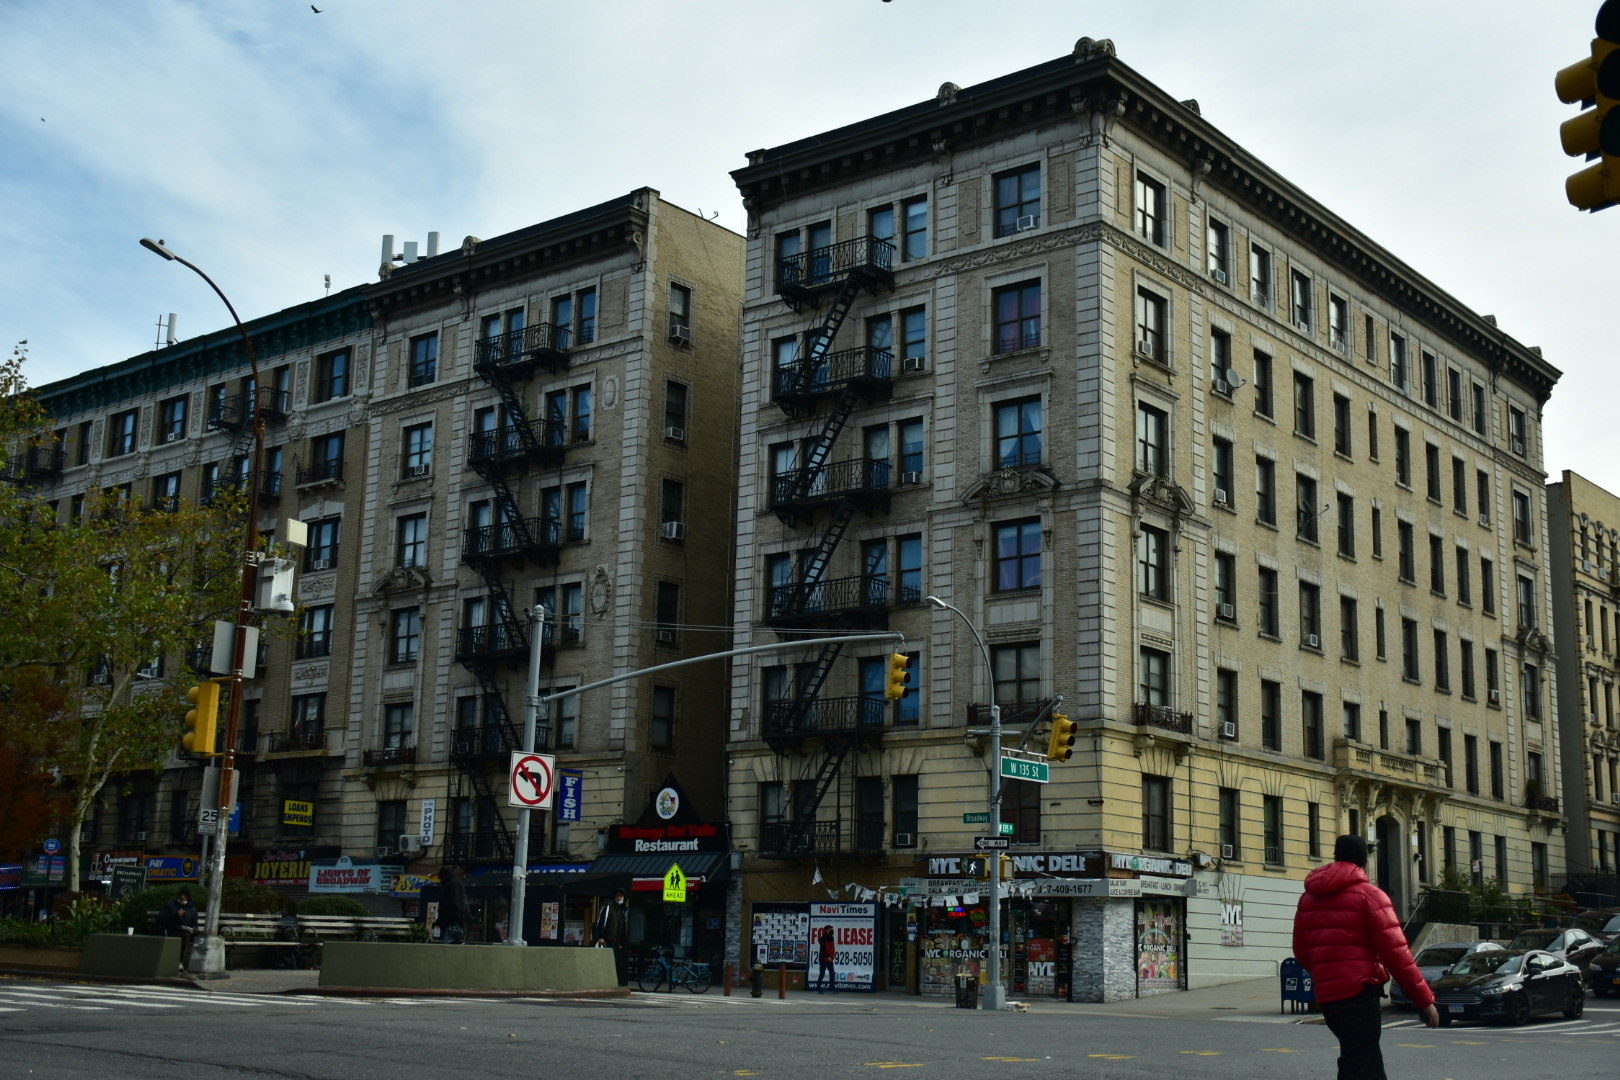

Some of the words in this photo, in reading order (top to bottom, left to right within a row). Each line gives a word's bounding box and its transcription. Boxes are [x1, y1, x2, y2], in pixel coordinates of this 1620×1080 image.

[1011, 762, 1018, 774] W
[1019, 763, 1030, 776] 135
[1032, 765, 1039, 778] St
[562, 776, 579, 819] FISH
[288, 803, 309, 813] LOANS
[202, 811, 218, 823] 25
[966, 814, 988, 823] Broadway
[423, 808, 433, 842] PHOTO
[618, 826, 666, 841] Mofongo
[667, 825, 687, 838] Del
[688, 824, 719, 838] Valle
[635, 838, 699, 852] Restaurant
[149, 859, 164, 868] PAY
[928, 857, 961, 874] NYC
[1175, 862, 1192, 875] DELI
[148, 868, 178, 877] OMATIC
[317, 869, 355, 878] LIGHTS
[357, 868, 371, 876] OF
[316, 876, 371, 885] BROADWAY
[1140, 880, 1159, 890] BREAKFAST
[1161, 882, 1172, 891] LUNCH
[666, 889, 684, 899] AHEAD
[1037, 884, 1093, 894] 97-409-1677
[1221, 904, 1242, 925] NYC
[837, 928, 873, 945] LEASE
[834, 951, 873, 966] 928-5050
[924, 950, 941, 958] NYC
[943, 949, 985, 958] ORGANIC
[1028, 962, 1054, 976] NYC
